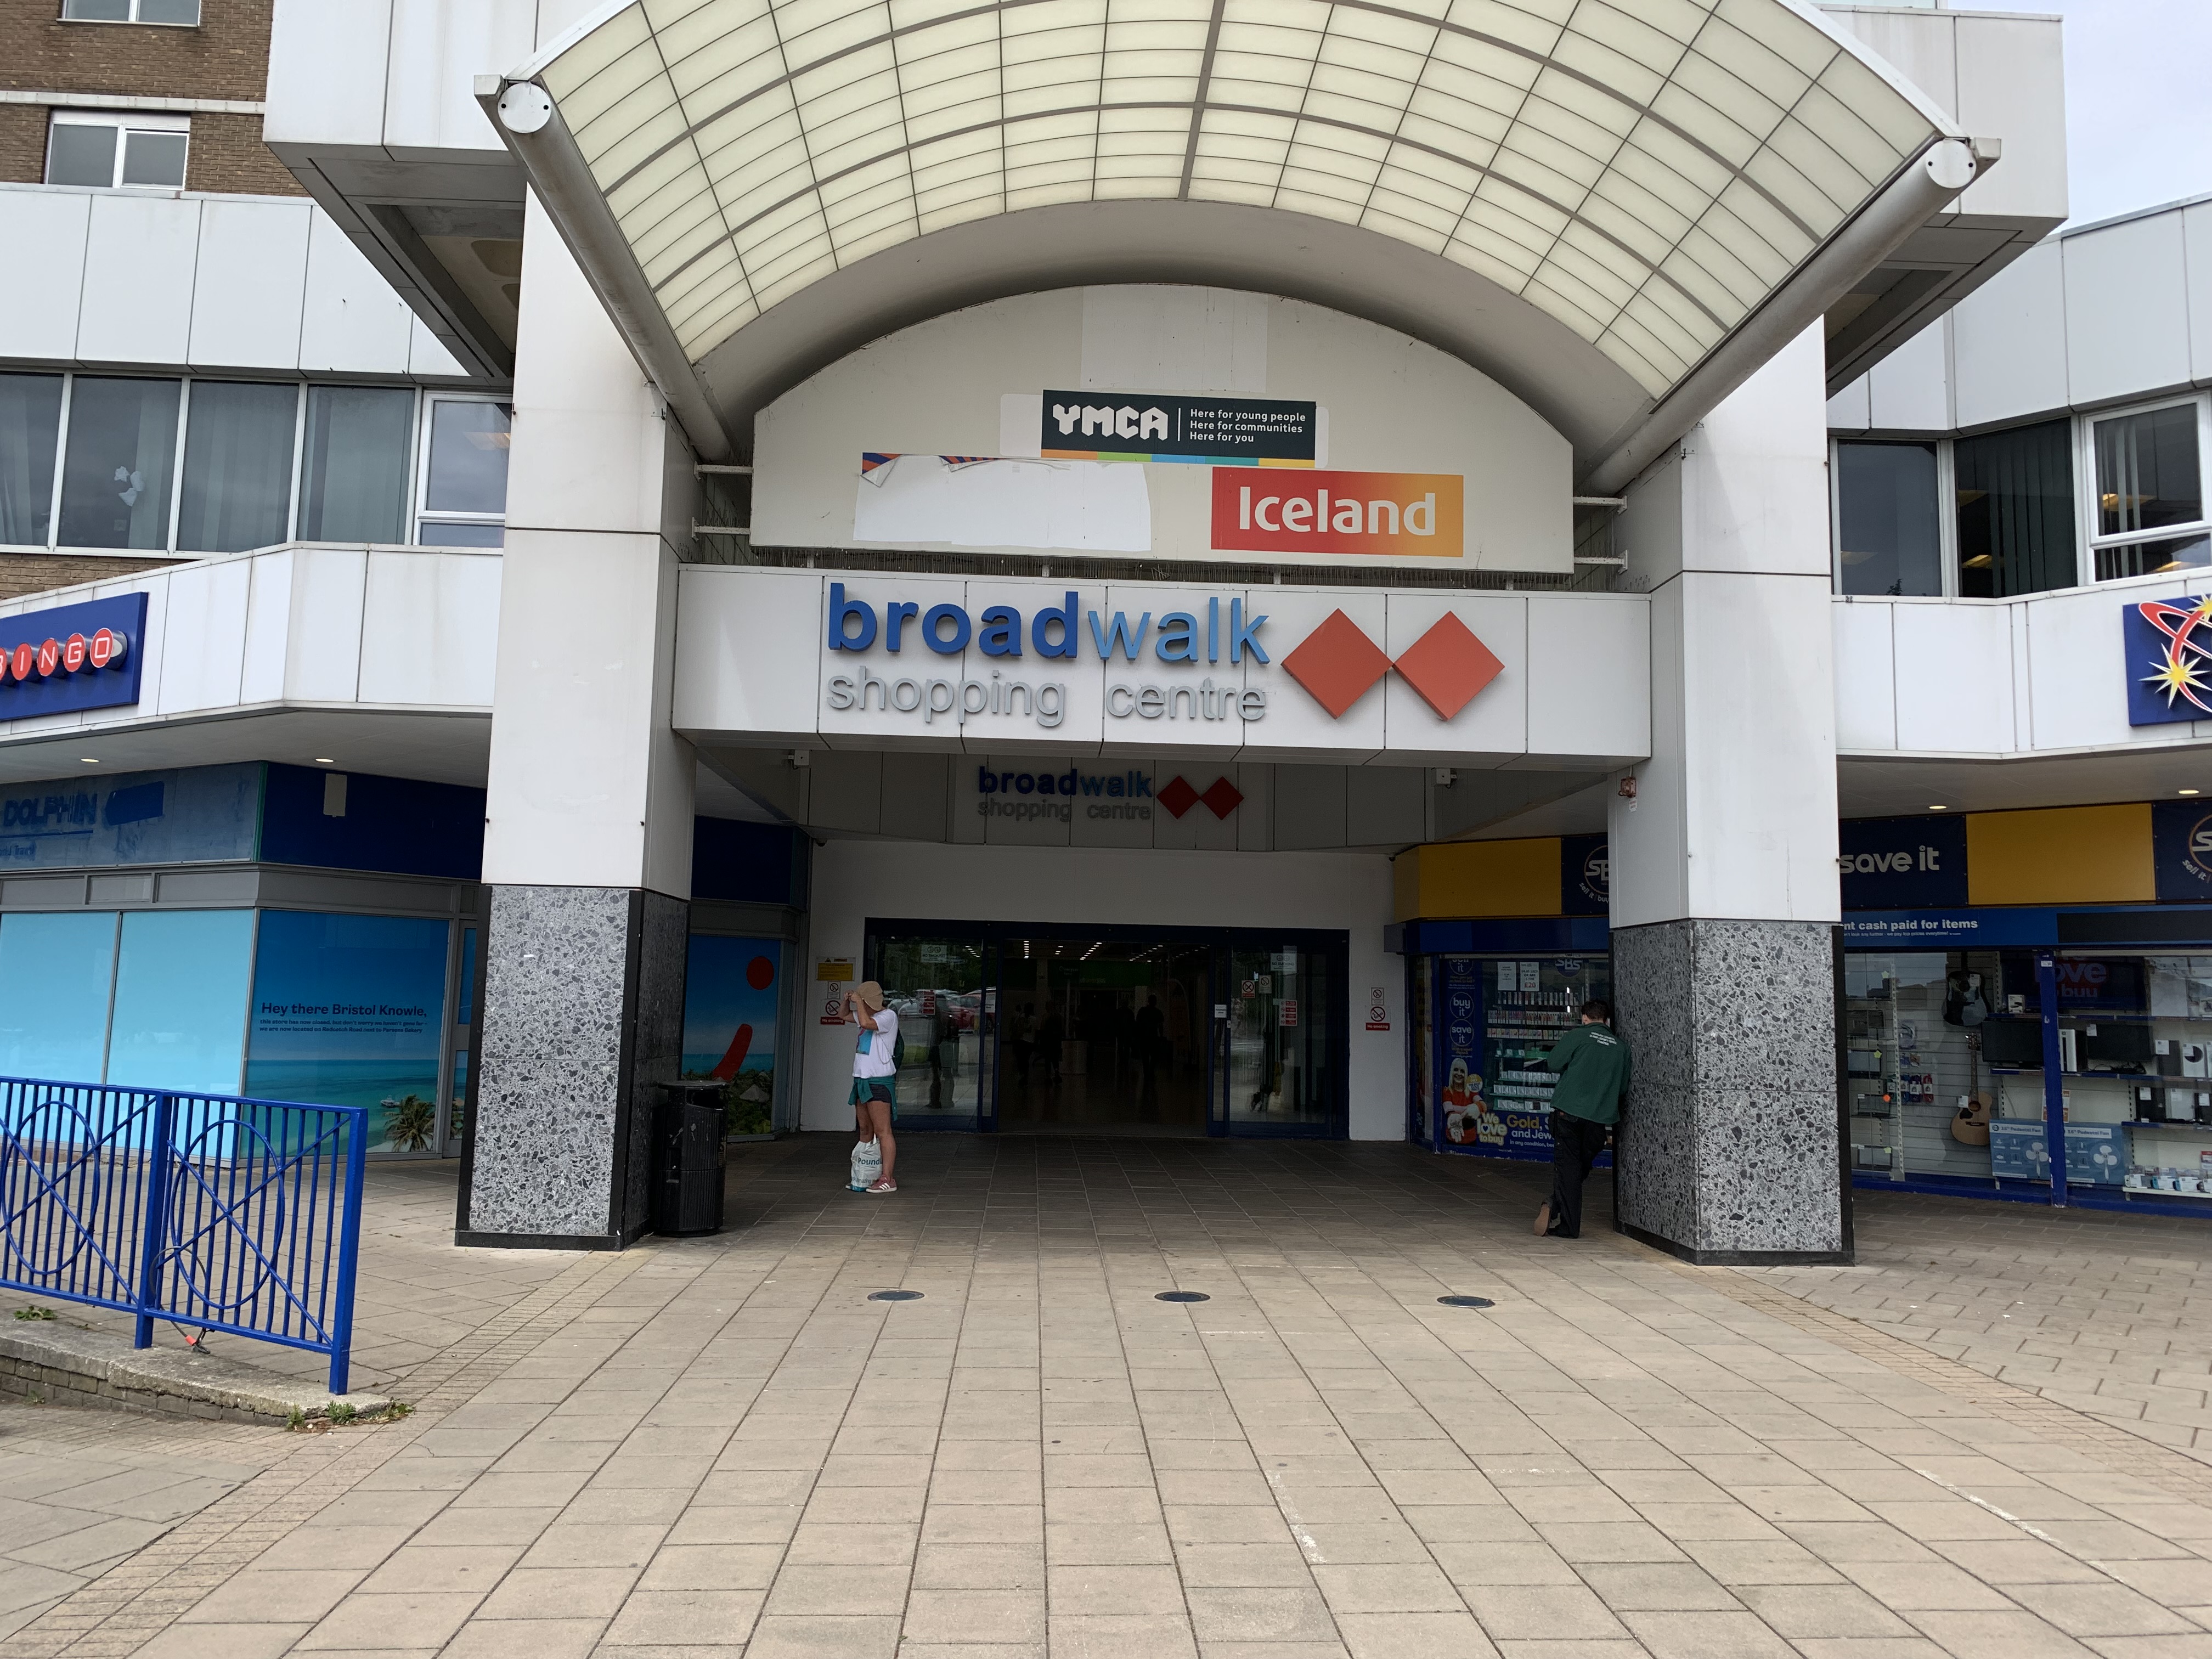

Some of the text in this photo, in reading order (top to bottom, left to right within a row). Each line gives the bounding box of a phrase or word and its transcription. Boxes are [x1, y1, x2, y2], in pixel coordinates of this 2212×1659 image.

[1190, 408, 1306, 422] Here for young people
[1053, 403, 1168, 441] YMCA
[1190, 420, 1303, 433] Here for communities
[1189, 431, 1254, 443] Here for you
[1239, 486, 1436, 537] Iceland
[828, 583, 1271, 665] broadwalk
[827, 665, 1267, 727] shopping centre
[979, 766, 1153, 798] broadwalk
[978, 798, 1150, 822] shopping centre
[1840, 845, 1940, 874] save it
[2182, 860, 2207, 881] sell it
[1579, 882, 1590, 895] sell
[1858, 921, 1887, 930] cash
[1891, 919, 1917, 932] paid
[1921, 919, 1939, 929] for
[1942, 919, 1978, 929] items
[1458, 963, 1464, 973] it
[1555, 958, 1583, 970] SBS
[1453, 997, 1471, 1009] buy
[261, 1002, 427, 1018] Hey there Bristol Knowle,
[1458, 1007, 1465, 1017] it
[1452, 1026, 1472, 1034] save
[1458, 1034, 1465, 1043] it
[1482, 1113, 1499, 1123] We
[1506, 1114, 1543, 1131] Gold,
[1477, 1119, 1507, 1136] love
[1511, 1128, 1531, 1138] and
[1488, 1135, 1504, 1146] buy
